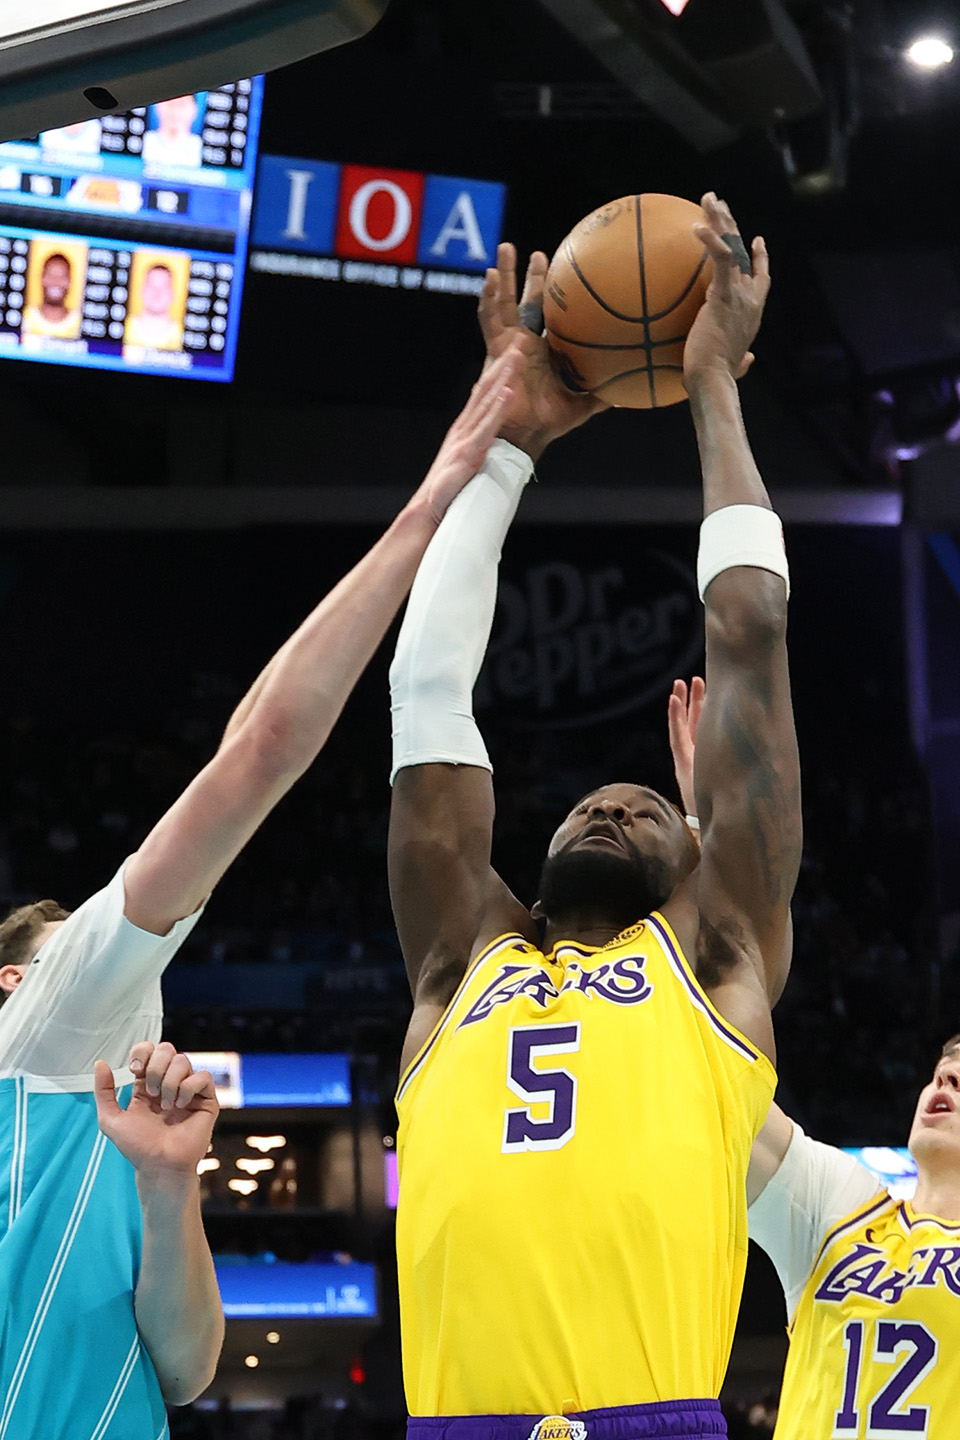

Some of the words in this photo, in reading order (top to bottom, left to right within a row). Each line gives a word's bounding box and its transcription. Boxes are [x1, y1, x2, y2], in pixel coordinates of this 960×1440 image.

[284, 168, 488, 261] IOA
[526, 561, 623, 638] Dr
[500, 1020, 582, 1154] 5
